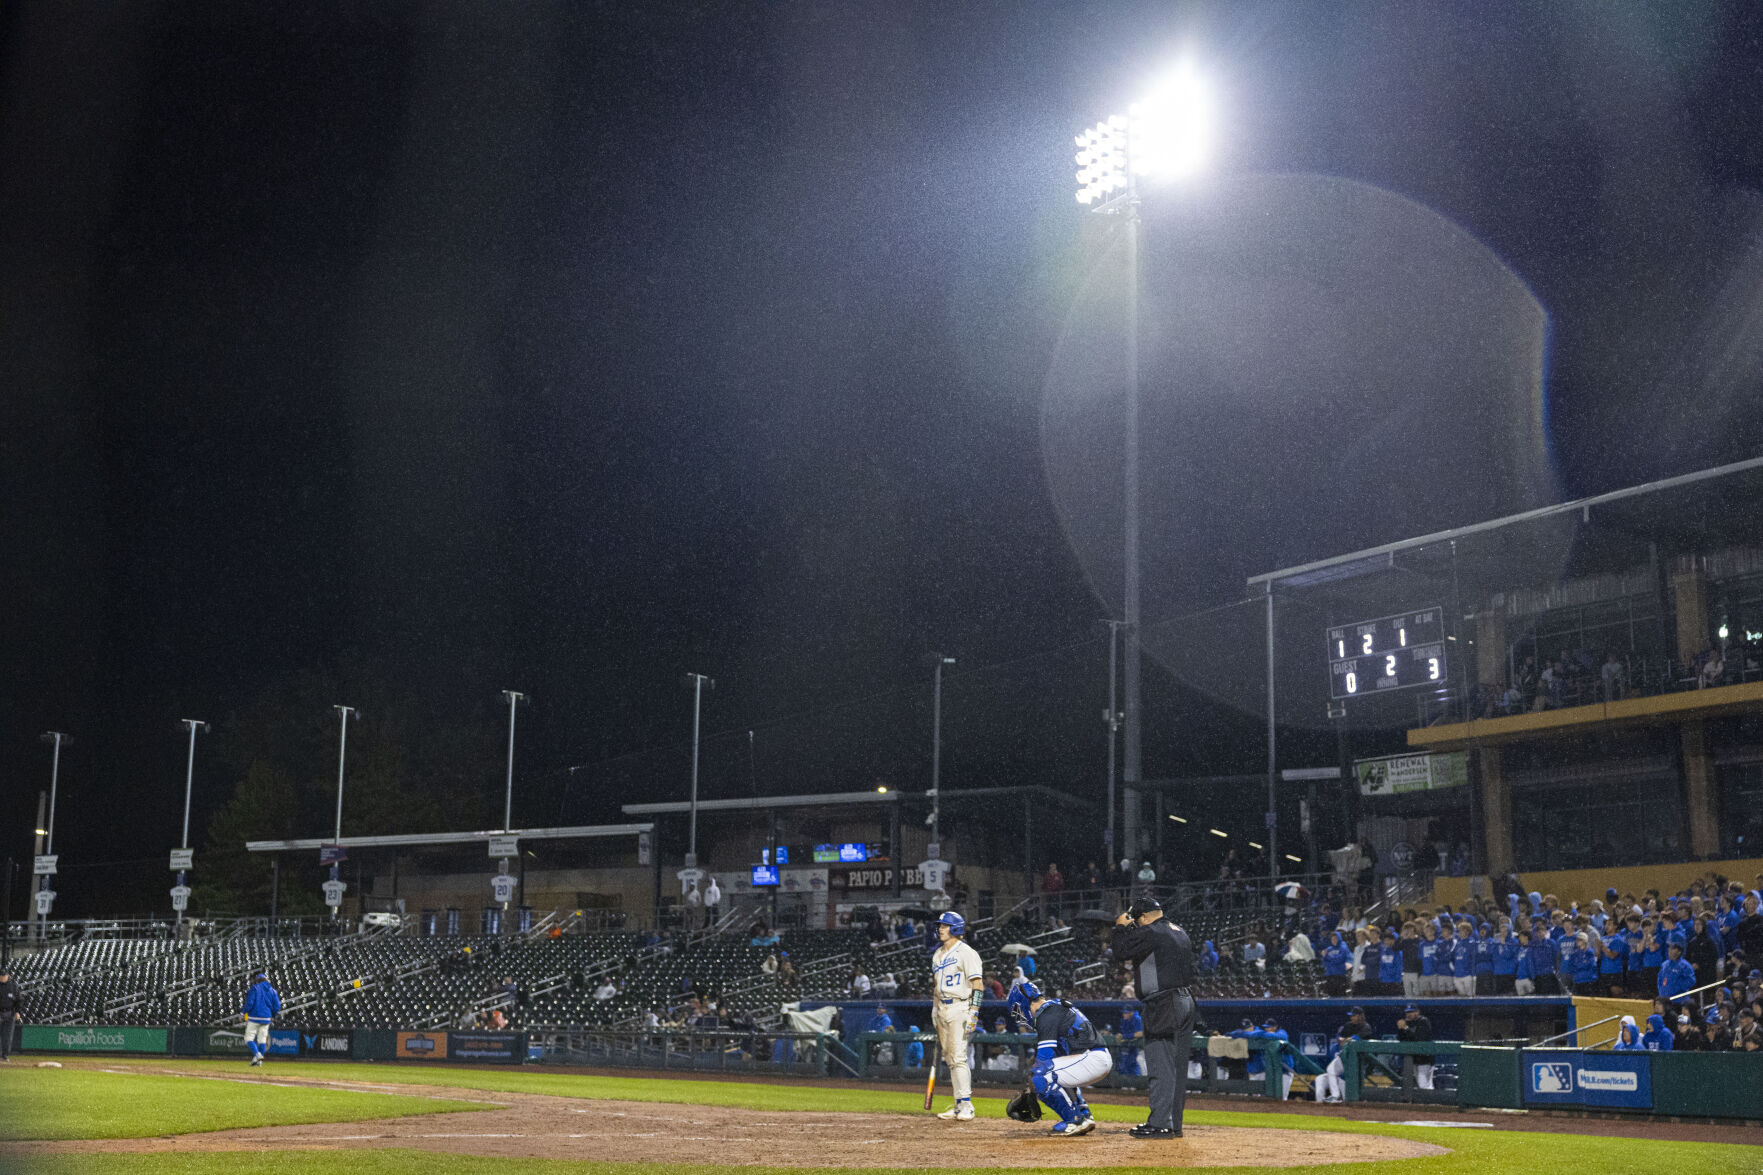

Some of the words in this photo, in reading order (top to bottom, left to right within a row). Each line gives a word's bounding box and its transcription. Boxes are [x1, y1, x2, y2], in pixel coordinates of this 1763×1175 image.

[1363, 634, 1373, 655] 2
[1400, 628, 1406, 647] 1
[1339, 640, 1344, 658] 1
[1333, 660, 1357, 675] GUEST
[1386, 655, 1396, 676] 2
[1428, 658, 1439, 680] 3
[1346, 672, 1357, 694] 0
[1391, 758, 1428, 768] RENEWAL
[848, 870, 882, 887] PAPIO
[930, 871, 937, 883] 5
[497, 885, 508, 896] 20
[946, 973, 960, 986] 27
[58, 1029, 96, 1048] Papillion
[97, 1032, 125, 1045] Foods
[321, 1037, 348, 1050] LANDING
[1580, 1074, 1634, 1086] MiLB.com/tickets
